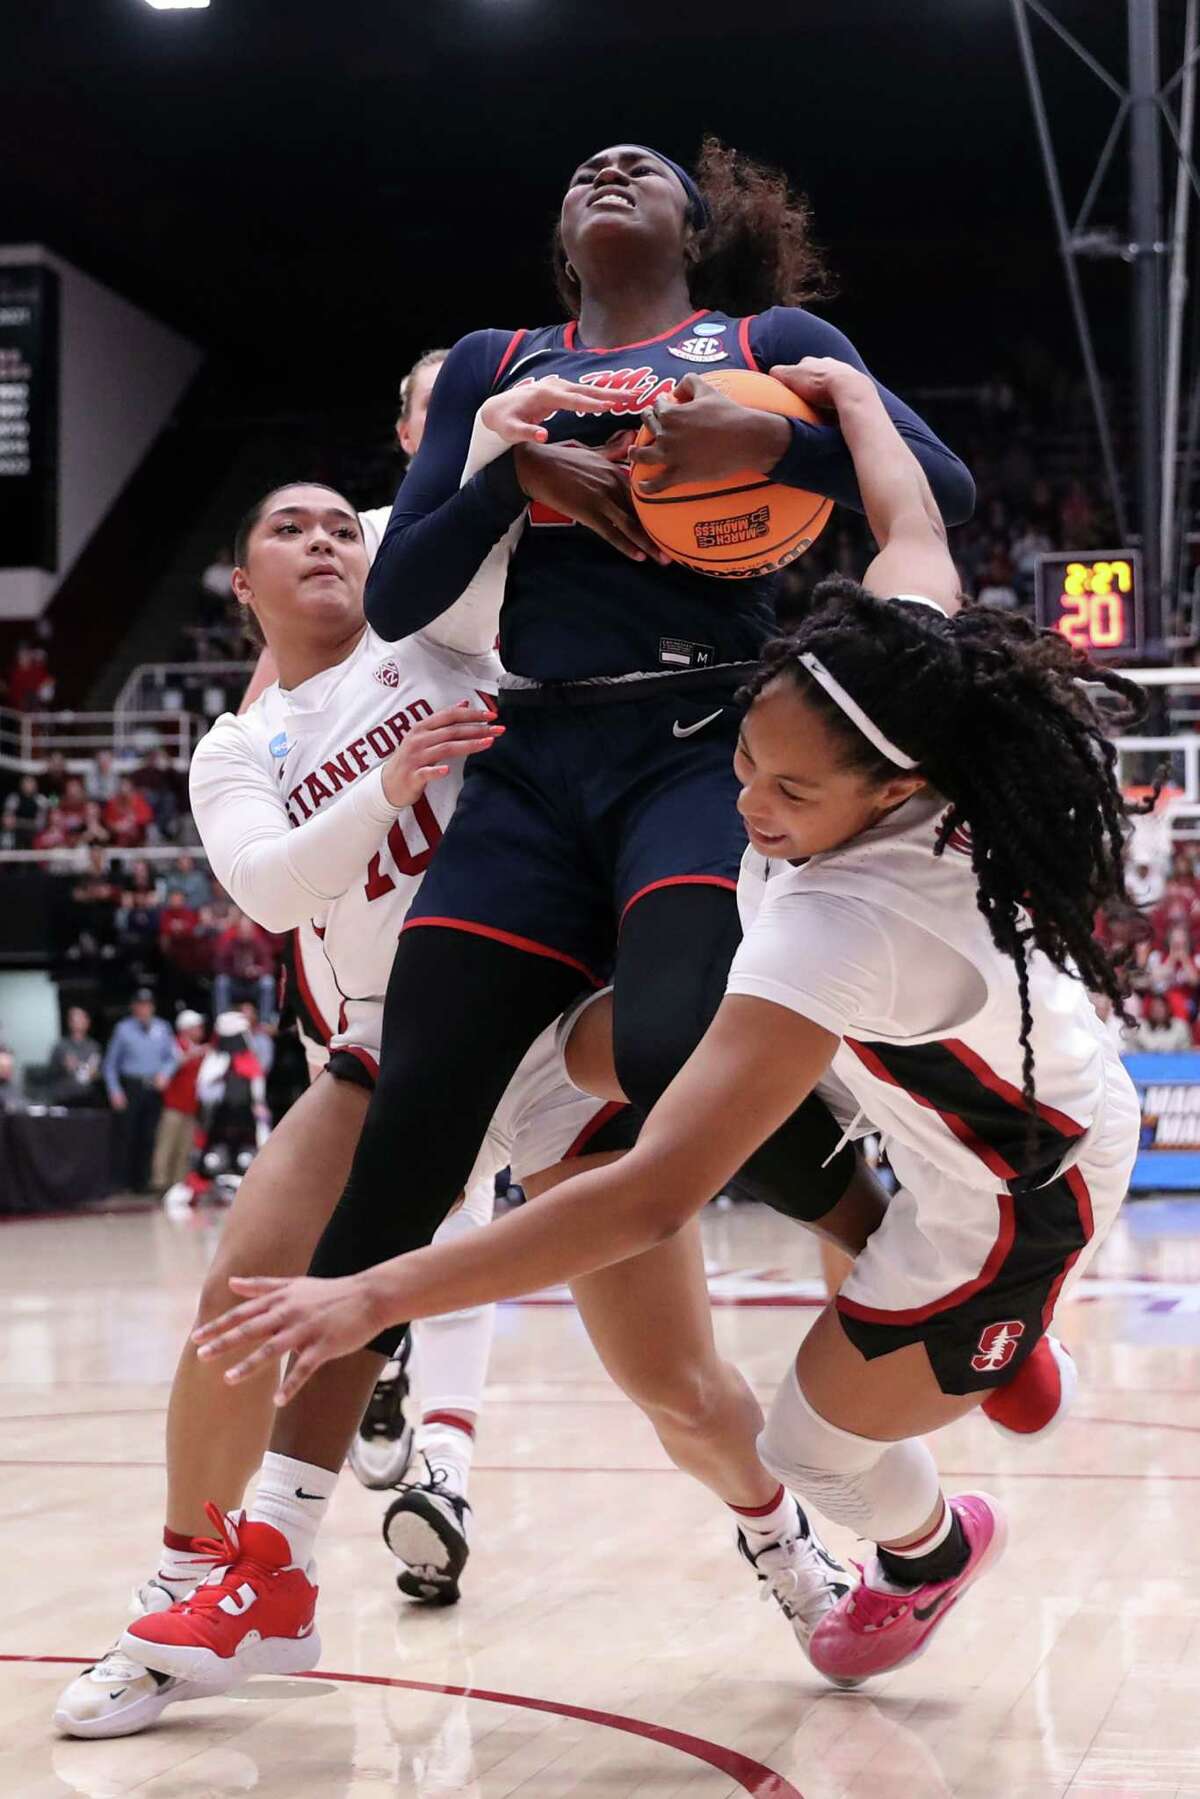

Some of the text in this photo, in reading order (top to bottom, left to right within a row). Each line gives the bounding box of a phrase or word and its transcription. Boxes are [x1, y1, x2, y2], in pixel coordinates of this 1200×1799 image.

[681, 337, 719, 355] SEC
[695, 519, 748, 537] MADNESS
[716, 527, 756, 545] MARCH
[1059, 592, 1123, 648] 20
[697, 651, 708, 664] M
